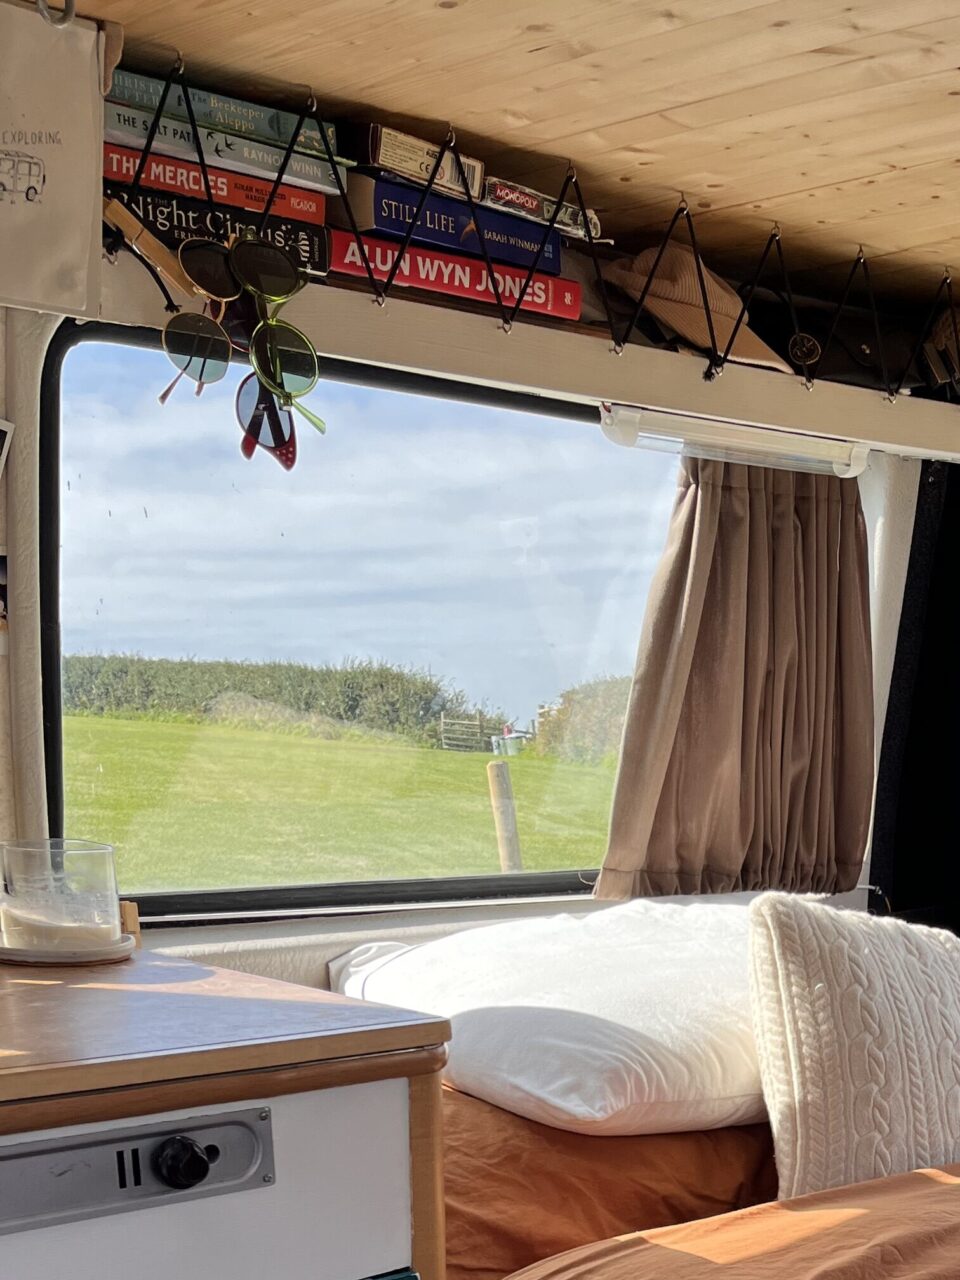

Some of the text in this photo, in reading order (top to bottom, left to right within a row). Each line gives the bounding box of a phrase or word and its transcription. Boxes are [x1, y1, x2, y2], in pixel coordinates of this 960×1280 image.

[114, 72, 164, 96] HRISTY
[210, 96, 264, 119] Beekeeper
[116, 112, 138, 129] THE
[142, 119, 168, 136] SLT
[215, 111, 255, 132] Aleppo
[1, 129, 63, 146] EXPLORING
[243, 147, 321, 178] RAYNO WINN
[150, 161, 228, 197] MERCIES
[290, 196, 317, 213] PICADOR
[496, 187, 538, 209] MONOPOLY
[119, 192, 199, 231] Night
[426, 210, 456, 234] LIFE
[543, 200, 574, 224] DAL
[484, 229, 508, 243] SARAH
[508, 235, 541, 252] WINMAN
[344, 241, 411, 276] ALUN
[416, 255, 471, 289] WYN
[476, 269, 546, 304] JONES
